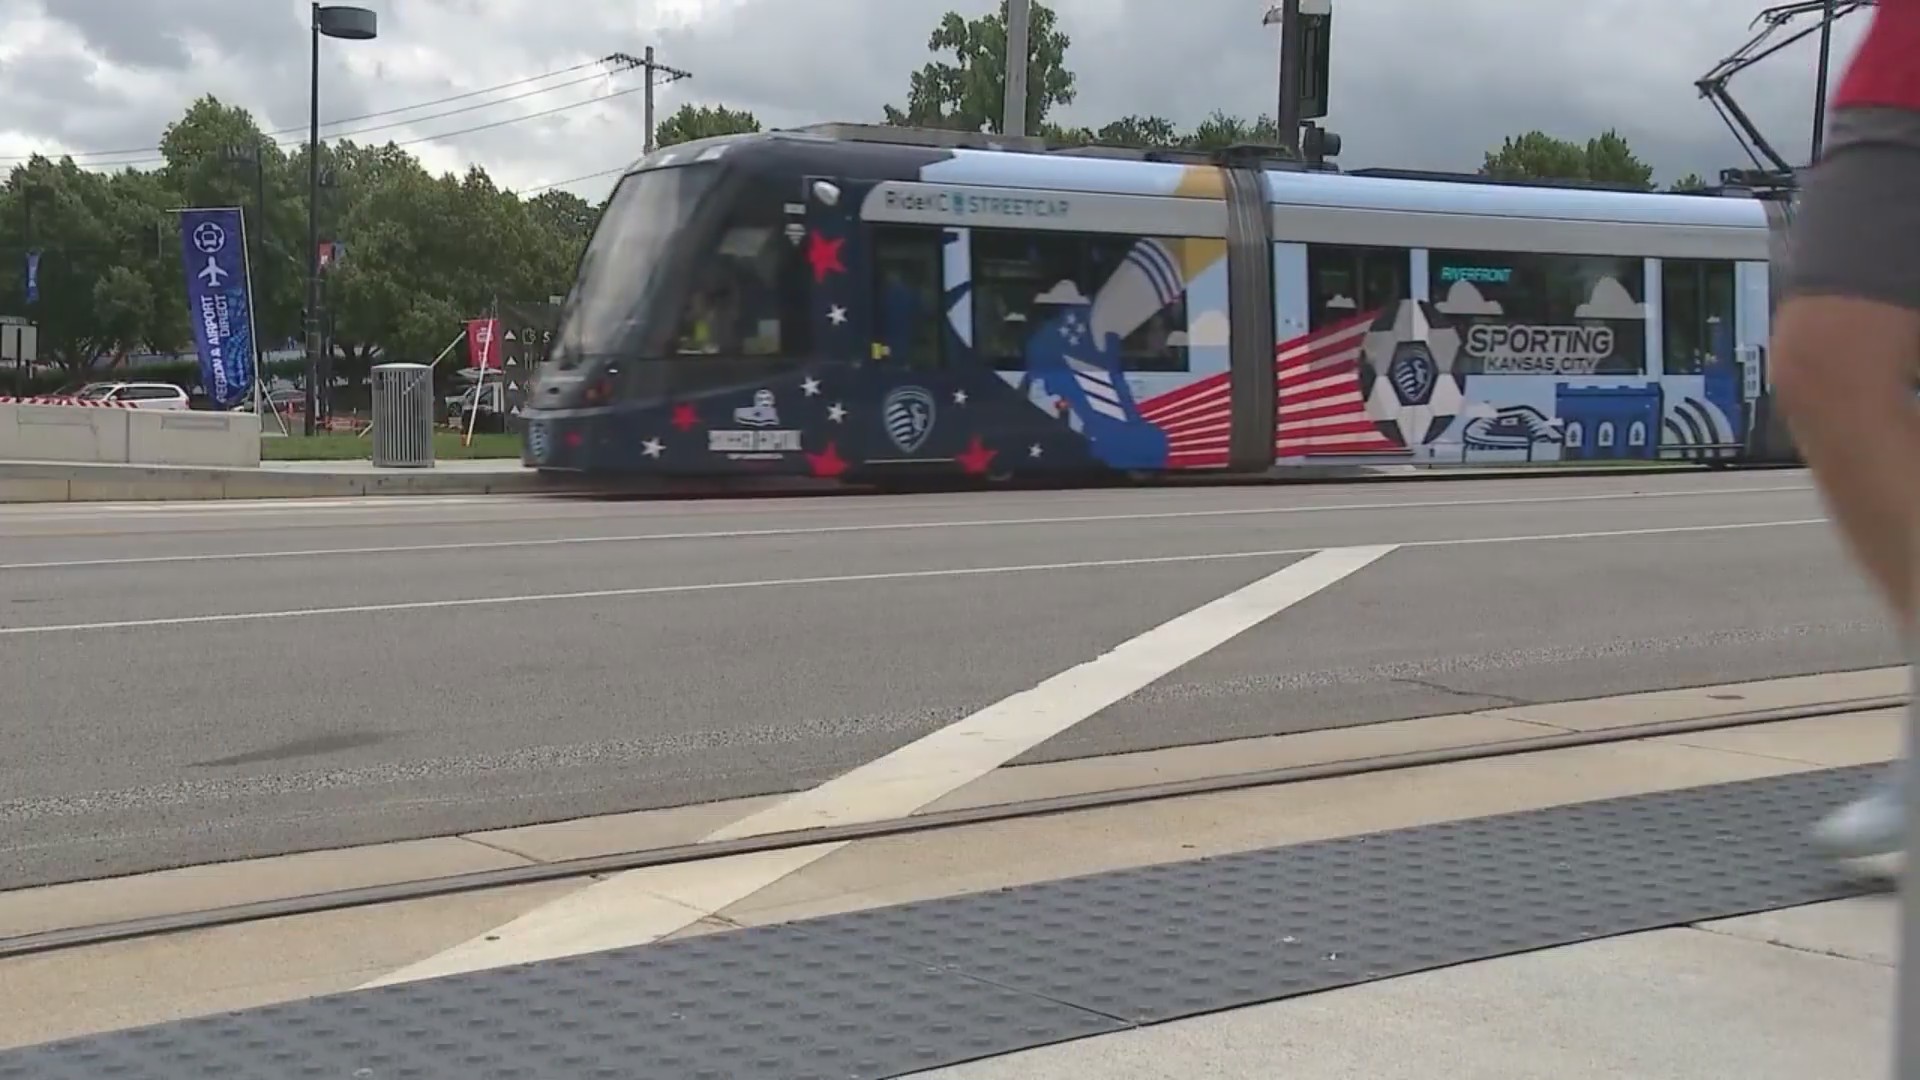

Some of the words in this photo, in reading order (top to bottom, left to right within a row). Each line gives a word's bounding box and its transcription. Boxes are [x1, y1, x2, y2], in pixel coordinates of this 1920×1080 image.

[968, 195, 1070, 217] STREETCAR
[1441, 266, 1512, 281] RIVERFRONT
[200, 295, 220, 346] AIRPORT
[214, 294, 230, 337] DIRECT
[1468, 327, 1612, 355] SPORTING
[1487, 356, 1555, 371] KANSAS
[1560, 357, 1595, 372] CITY
[212, 358, 228, 404] REGION
